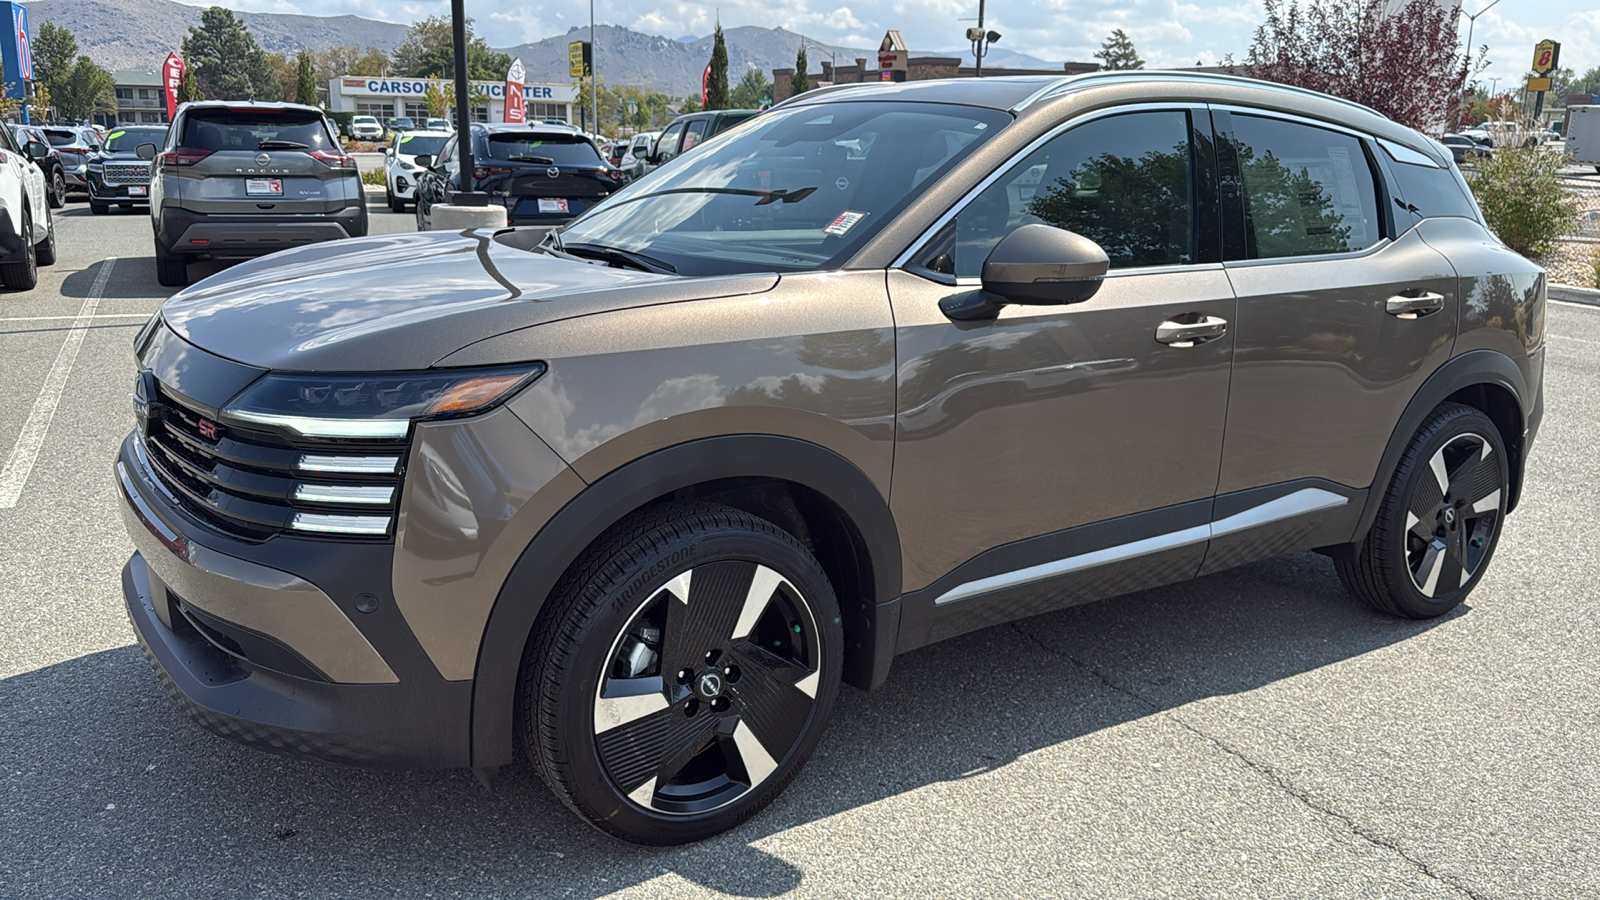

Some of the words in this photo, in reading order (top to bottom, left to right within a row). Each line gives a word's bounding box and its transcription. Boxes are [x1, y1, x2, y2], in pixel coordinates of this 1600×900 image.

[18, 9, 32, 79] 6
[1538, 51, 1551, 66] 8
[199, 419, 216, 440] SR
[611, 543, 697, 613] BRIDGESTONE
